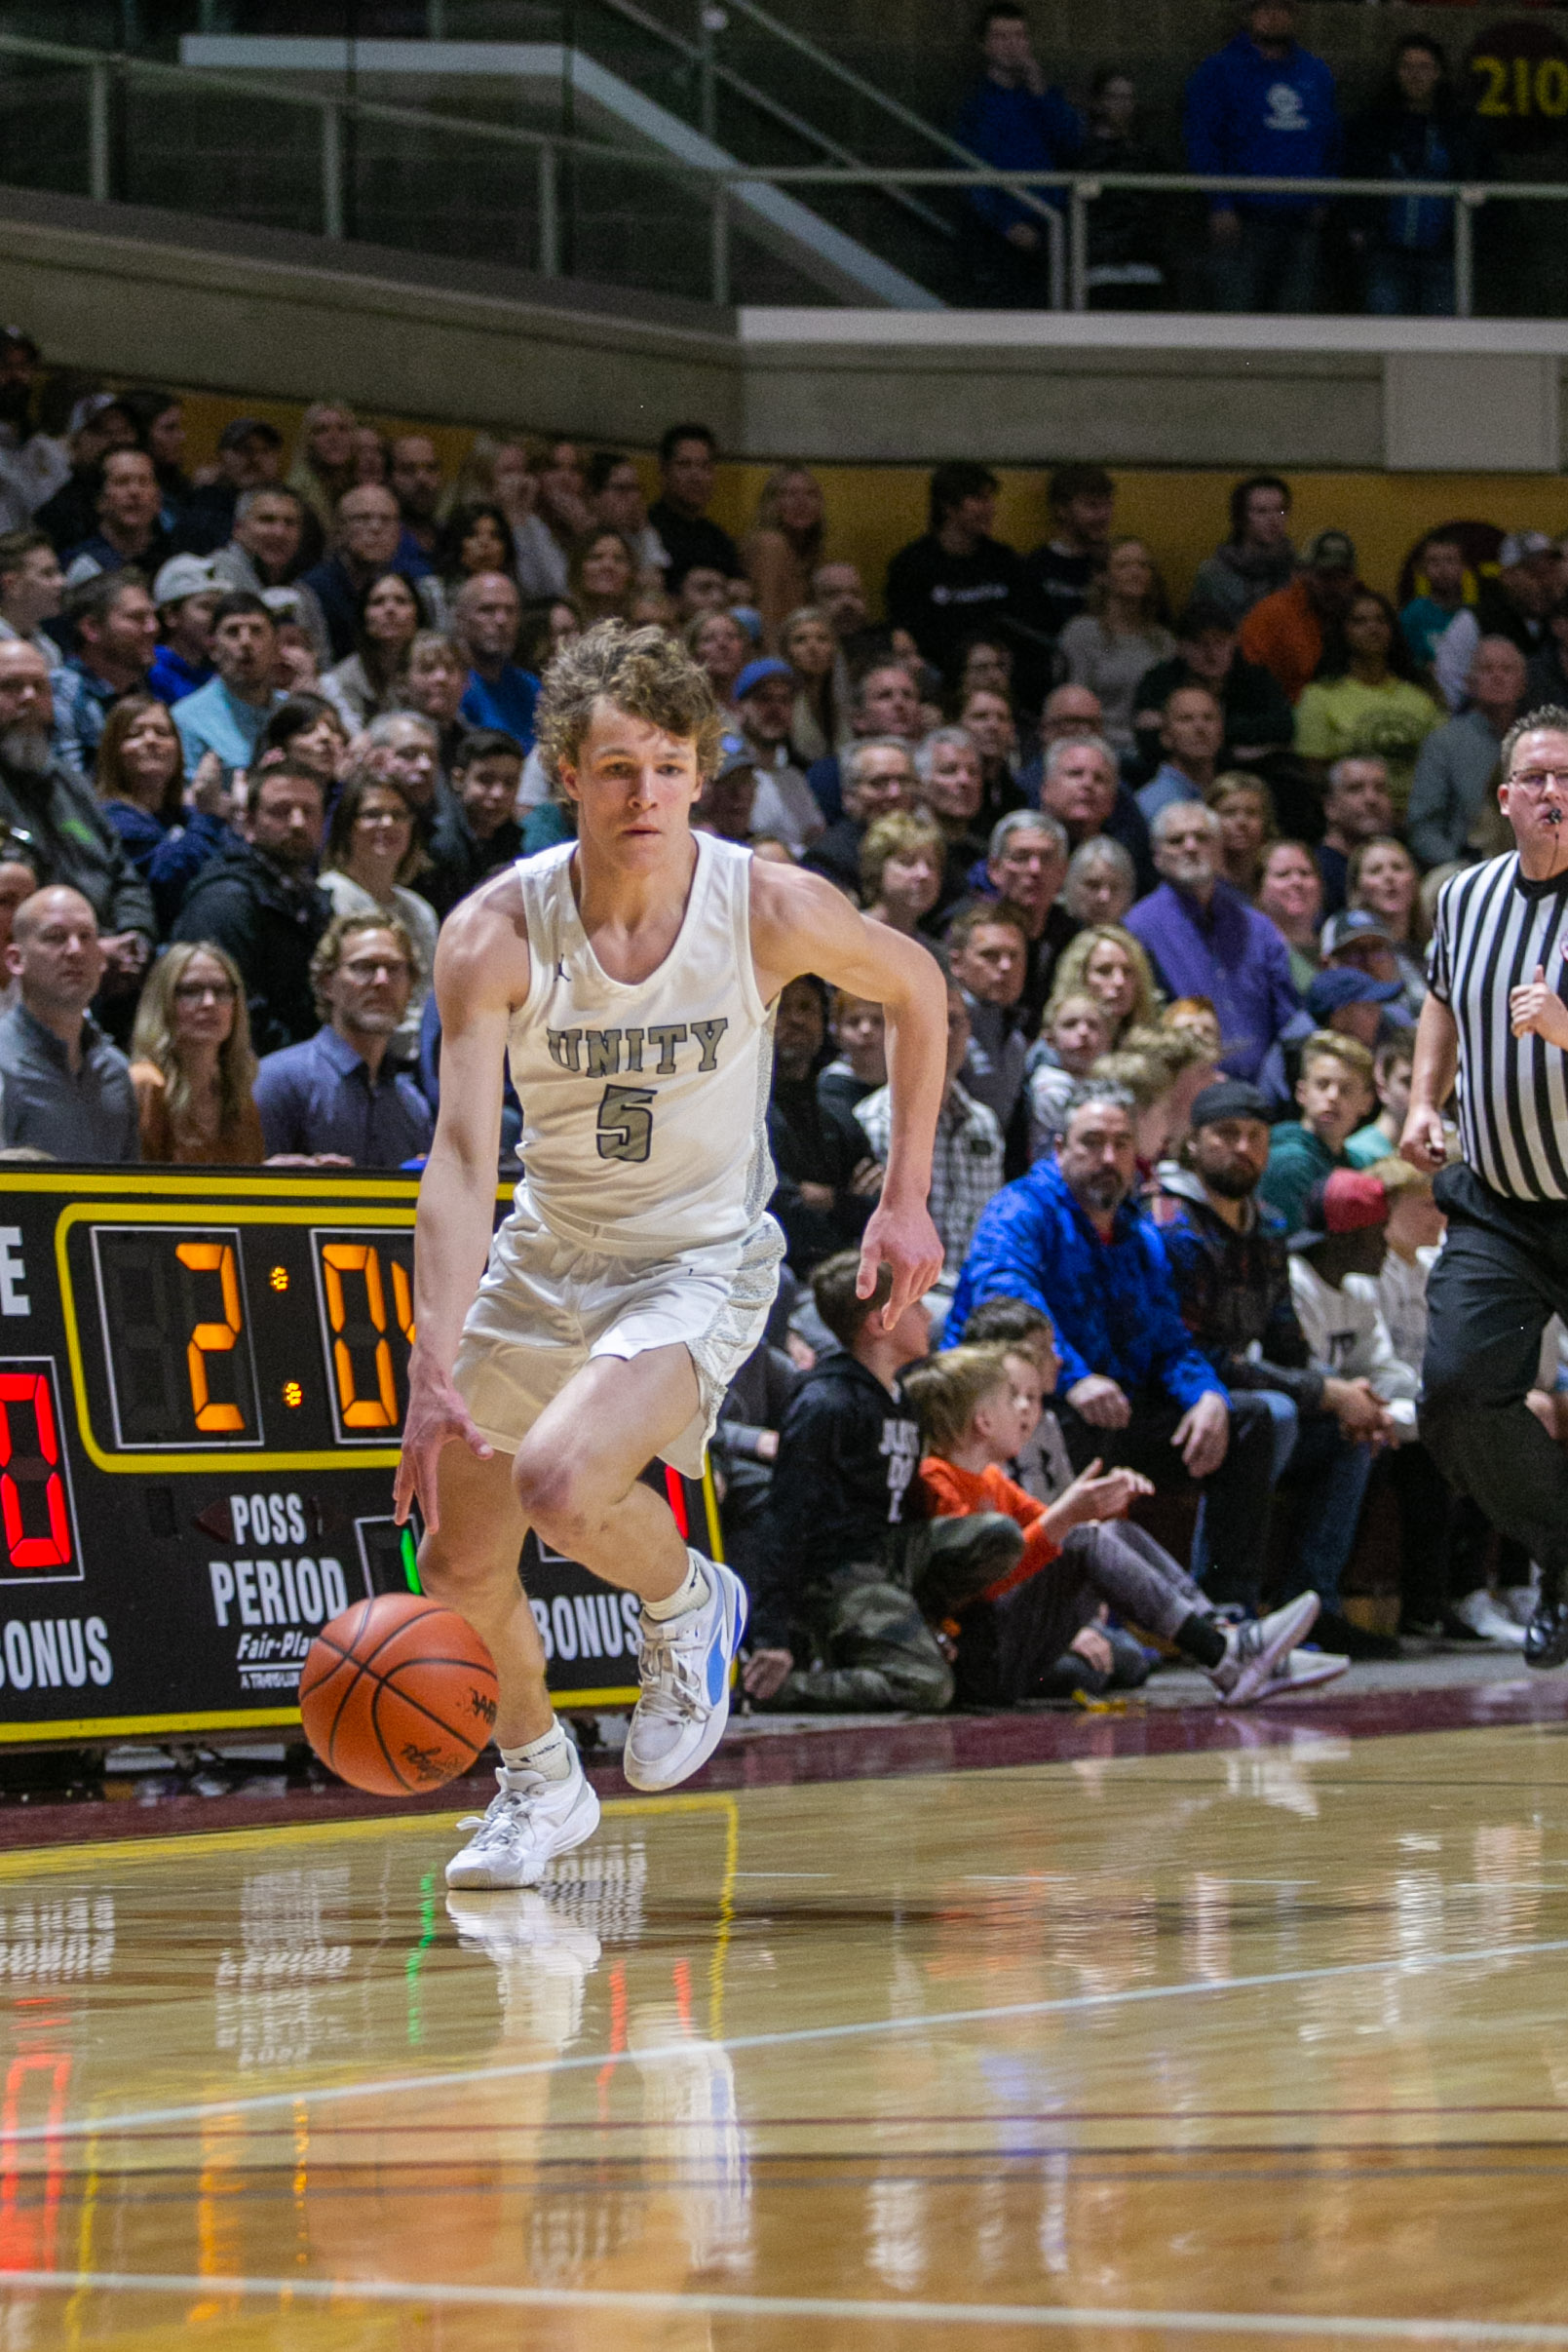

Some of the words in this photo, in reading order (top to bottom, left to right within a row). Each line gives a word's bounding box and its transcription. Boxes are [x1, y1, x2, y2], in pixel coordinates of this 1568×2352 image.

[1472, 57, 1568, 116] 210
[546, 1018, 728, 1078] UNITY
[595, 1084, 658, 1162] 5
[230, 1492, 307, 1546] POSS
[209, 1556, 349, 1627] PERIOD
[0, 1615, 113, 1691] ONUS
[529, 1592, 646, 1661] BONUS
